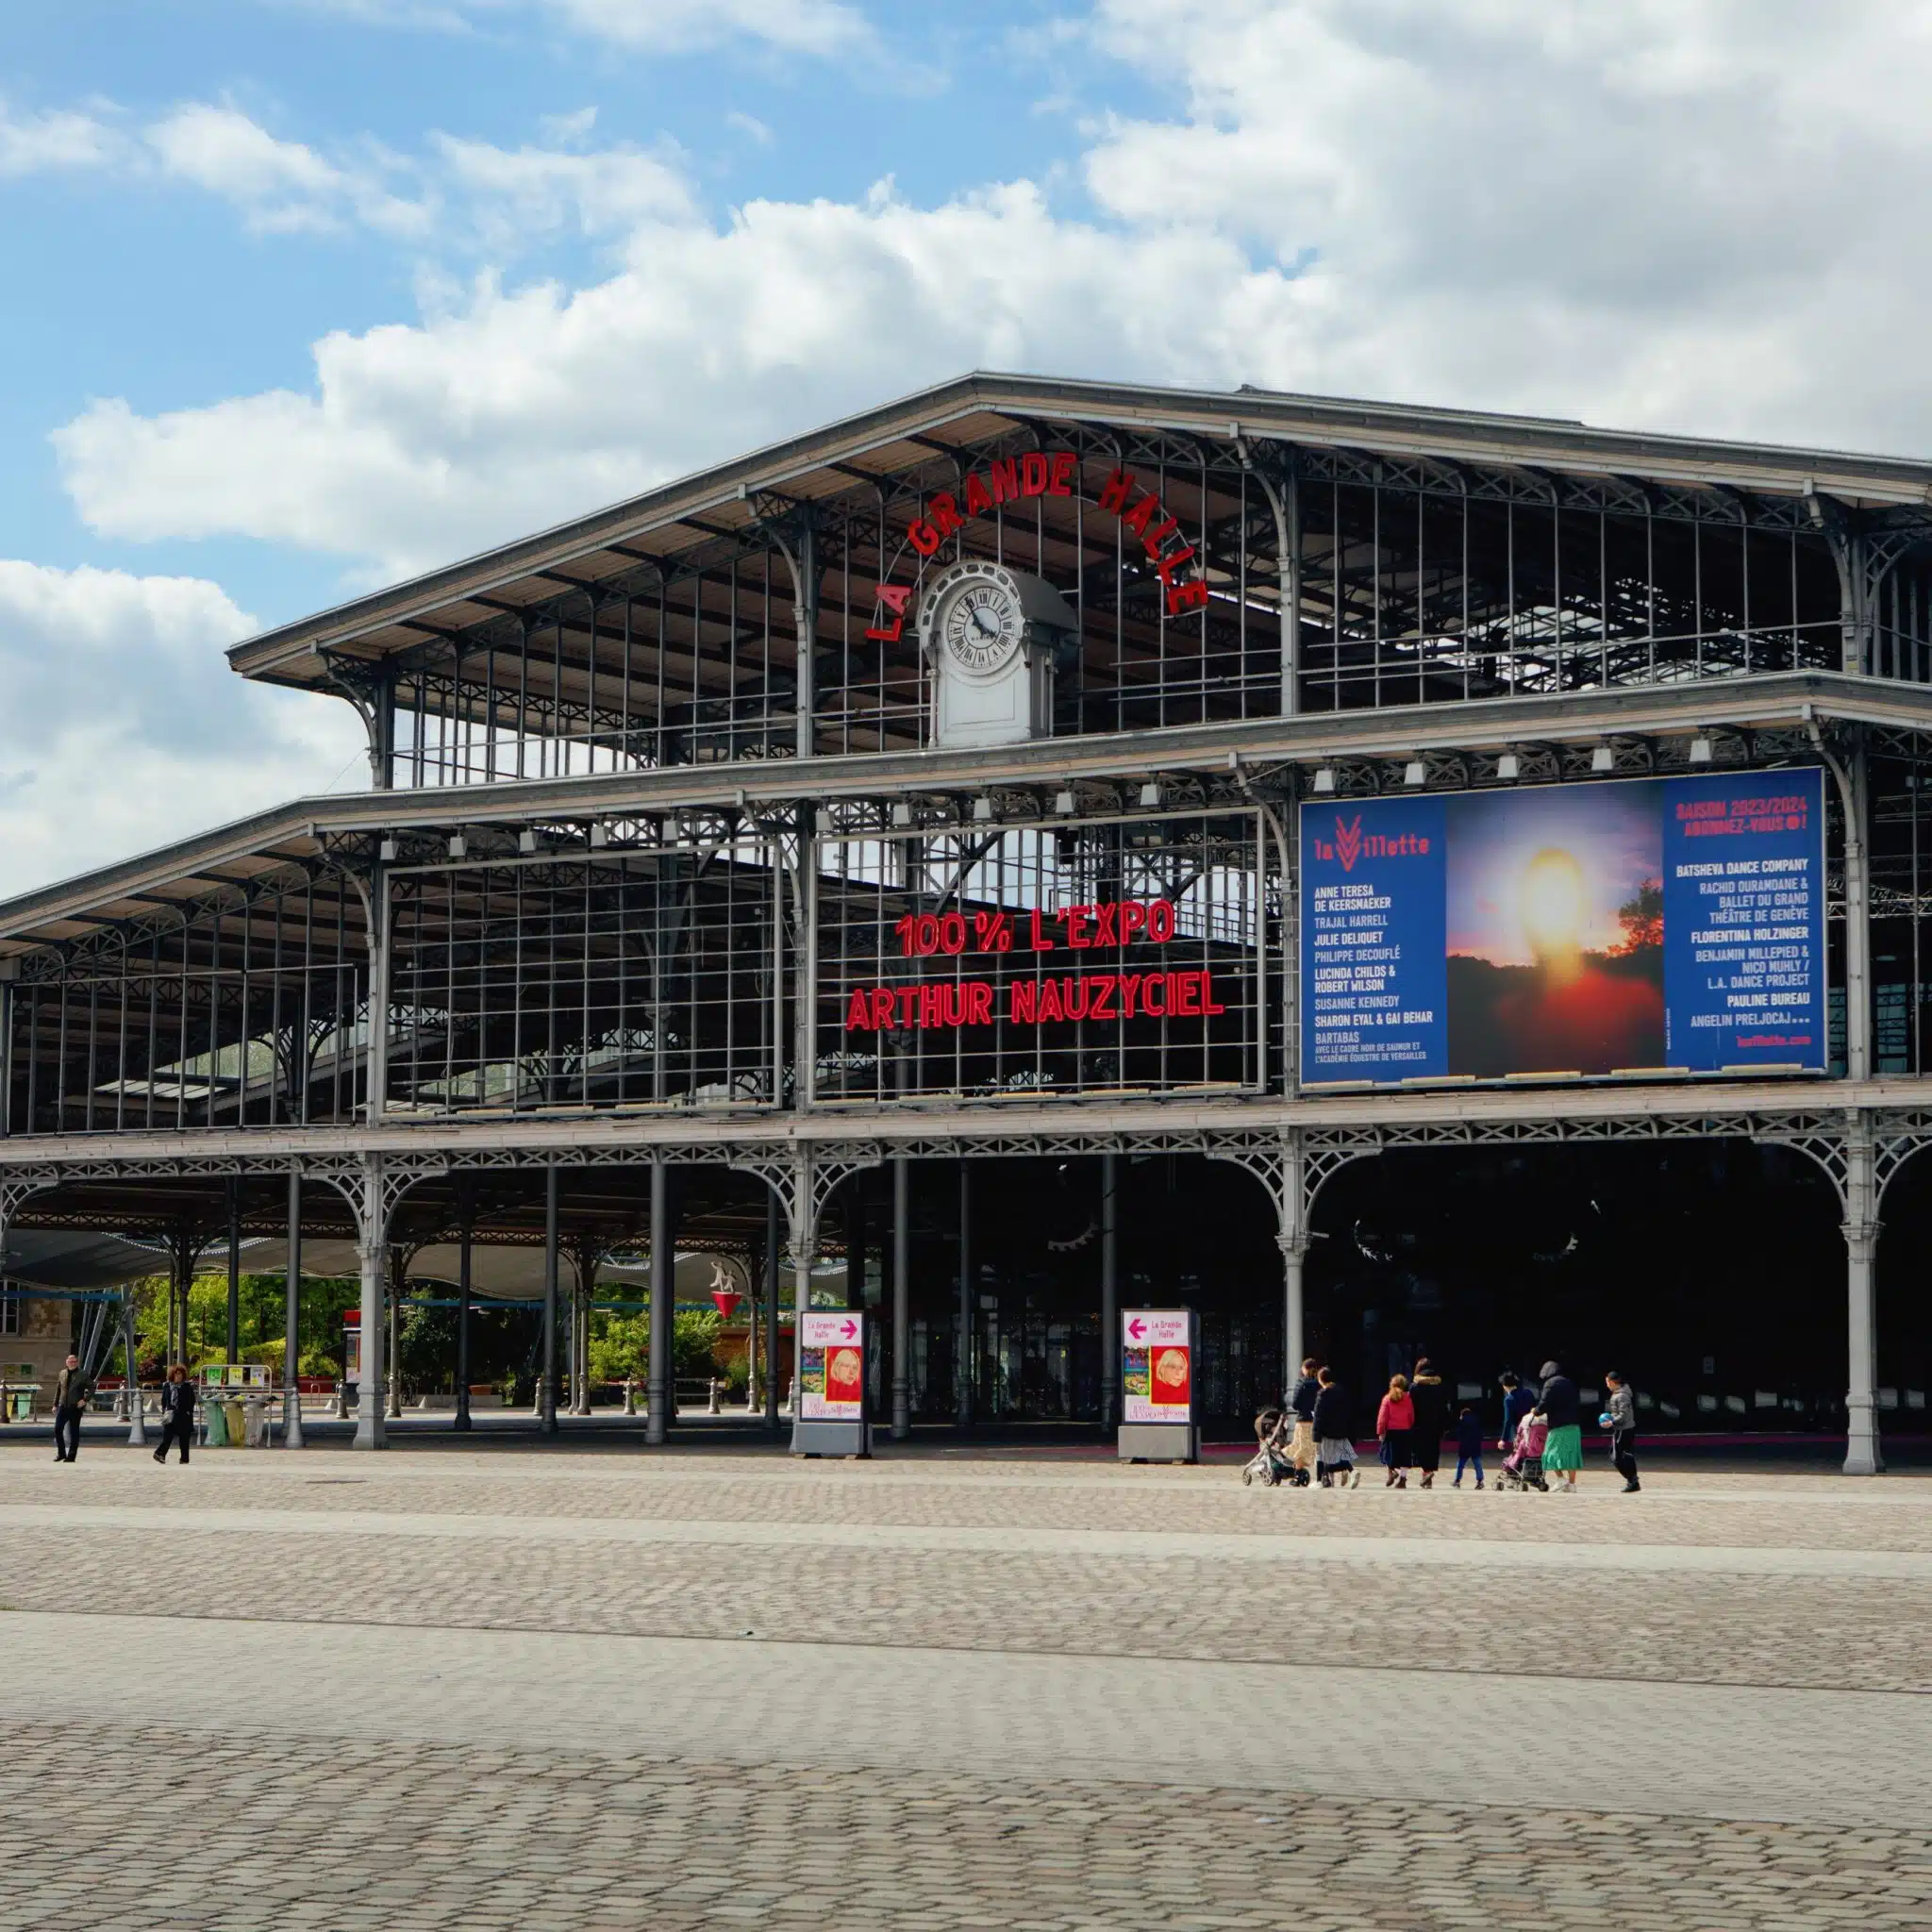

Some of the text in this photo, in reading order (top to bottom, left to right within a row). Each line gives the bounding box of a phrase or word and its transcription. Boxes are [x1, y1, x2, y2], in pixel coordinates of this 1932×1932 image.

[863, 452, 1208, 642] LA GRANDE HALLE
[1675, 796, 1808, 820] SAISON 2023/2024
[1313, 839, 1333, 860] la
[1676, 858, 1808, 877] BATSHEVA DANCE COMPANY
[1314, 884, 1374, 899] ANNE TERESA
[1699, 877, 1808, 895] RACHID OURAMDANE &
[1314, 897, 1391, 912] DE KEERSMAEKER
[1719, 892, 1808, 908] BALLET DU GRAND
[1314, 914, 1390, 929] TRAJAL HARRELL
[1709, 906, 1809, 924] THÉÂTRE DE GENÈVE
[1031, 900, 1175, 952] L'EXPO
[1313, 931, 1384, 947] JULIE DELIQUET
[1690, 926, 1809, 944] FLORENTINA HOLZINGER
[1314, 944, 1401, 963] PHILIPPE DECOUFLÉ
[1695, 944, 1809, 963] BENJAMIN MILLEPIED &
[1314, 965, 1396, 980] LUCINDA CHILDS &
[1741, 962, 1766, 974] NICO
[1769, 960, 1801, 974] MUHLY
[1314, 979, 1385, 993] ROBERT WILSON
[1707, 974, 1810, 990] L.A. DANCE PROJECT
[846, 972, 1225, 1030] ARTHUR NAUZYCIEL
[1314, 995, 1400, 1010] SUSANNE KENNEDY
[1727, 992, 1810, 1008] PAULINE BUREAU
[1314, 1010, 1434, 1027] SHARON EYAL & GAI BEHAR
[1690, 1014, 1733, 1027] ANGELIN
[1315, 1031, 1360, 1044] BARTABAS
[1315, 1044, 1330, 1054] AVEC
[1331, 1044, 1339, 1054] LE
[1340, 1043, 1359, 1053] CADRE
[1360, 1042, 1375, 1053] NOIR
[1376, 1042, 1385, 1052] DE
[1412, 1041, 1421, 1050] ET
[1381, 1052, 1390, 1061] DE
[1391, 1050, 1427, 1061] VERSAILLES
[1158, 1330, 1175, 1339] Halle
